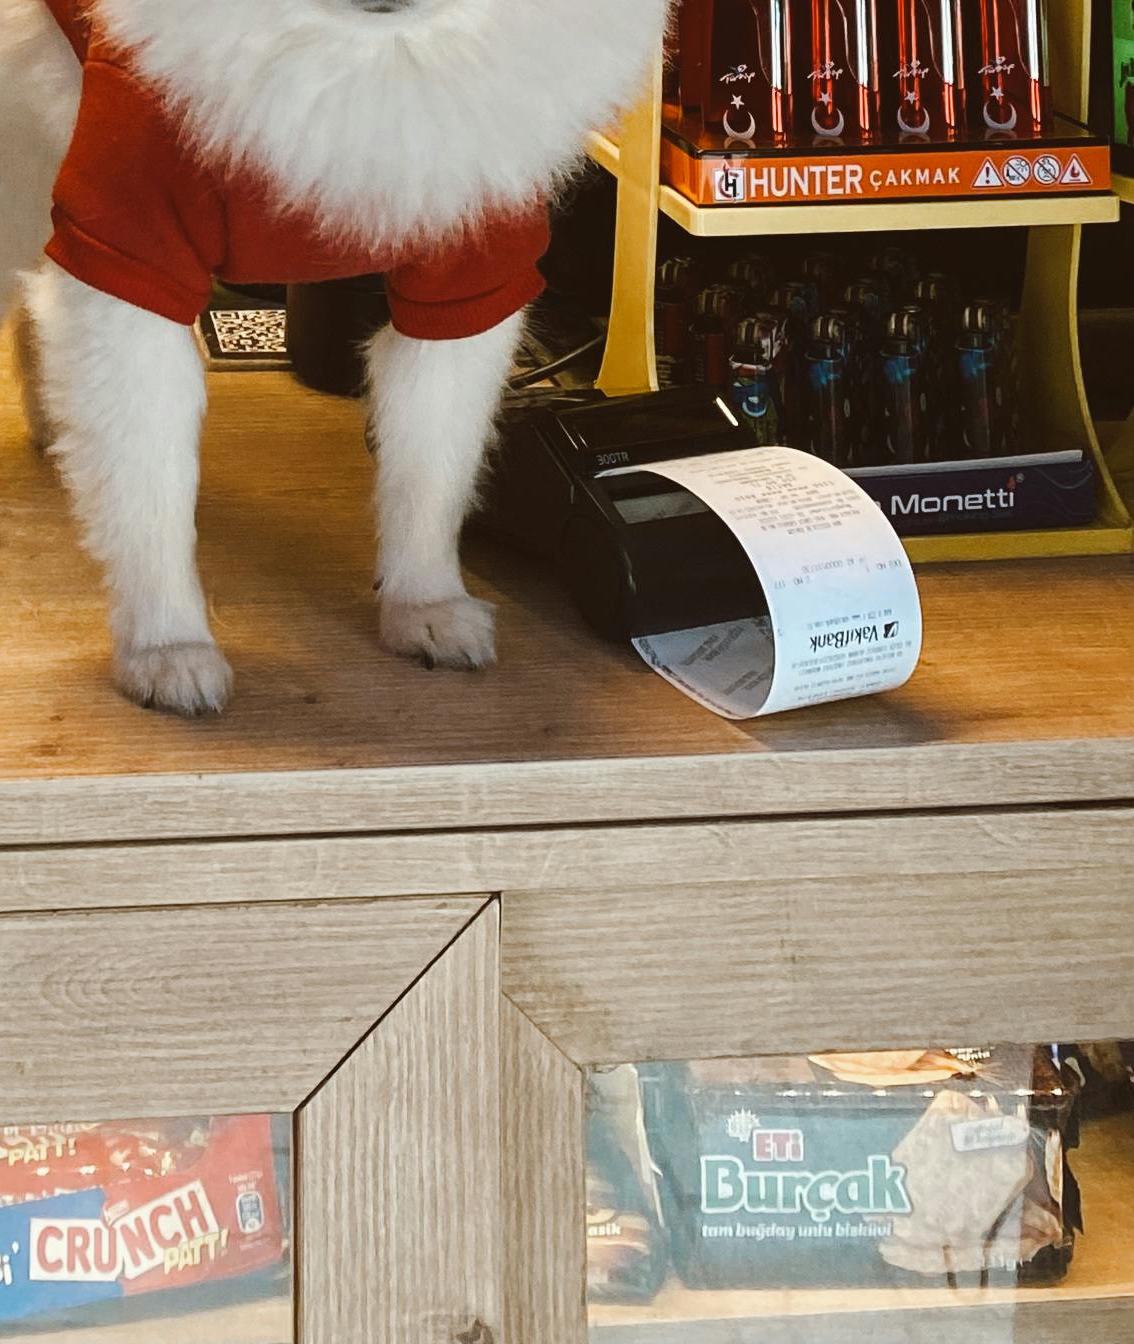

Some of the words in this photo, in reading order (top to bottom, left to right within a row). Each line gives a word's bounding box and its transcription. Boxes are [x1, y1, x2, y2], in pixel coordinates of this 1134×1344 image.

[750, 164, 864, 198] HUNTER
[869, 167, 961, 192] ÇAKMAK
[891, 484, 1015, 516] Monetti
[809, 624, 879, 653] VakıfBank
[701, 1155, 912, 1223] Burçak
[36, 1188, 210, 1274] CRUNCH
[587, 1223, 621, 1238] asik
[702, 1223, 734, 1238] tam
[736, 1222, 796, 1242] buğday
[162, 1227, 230, 1276] PATT!
